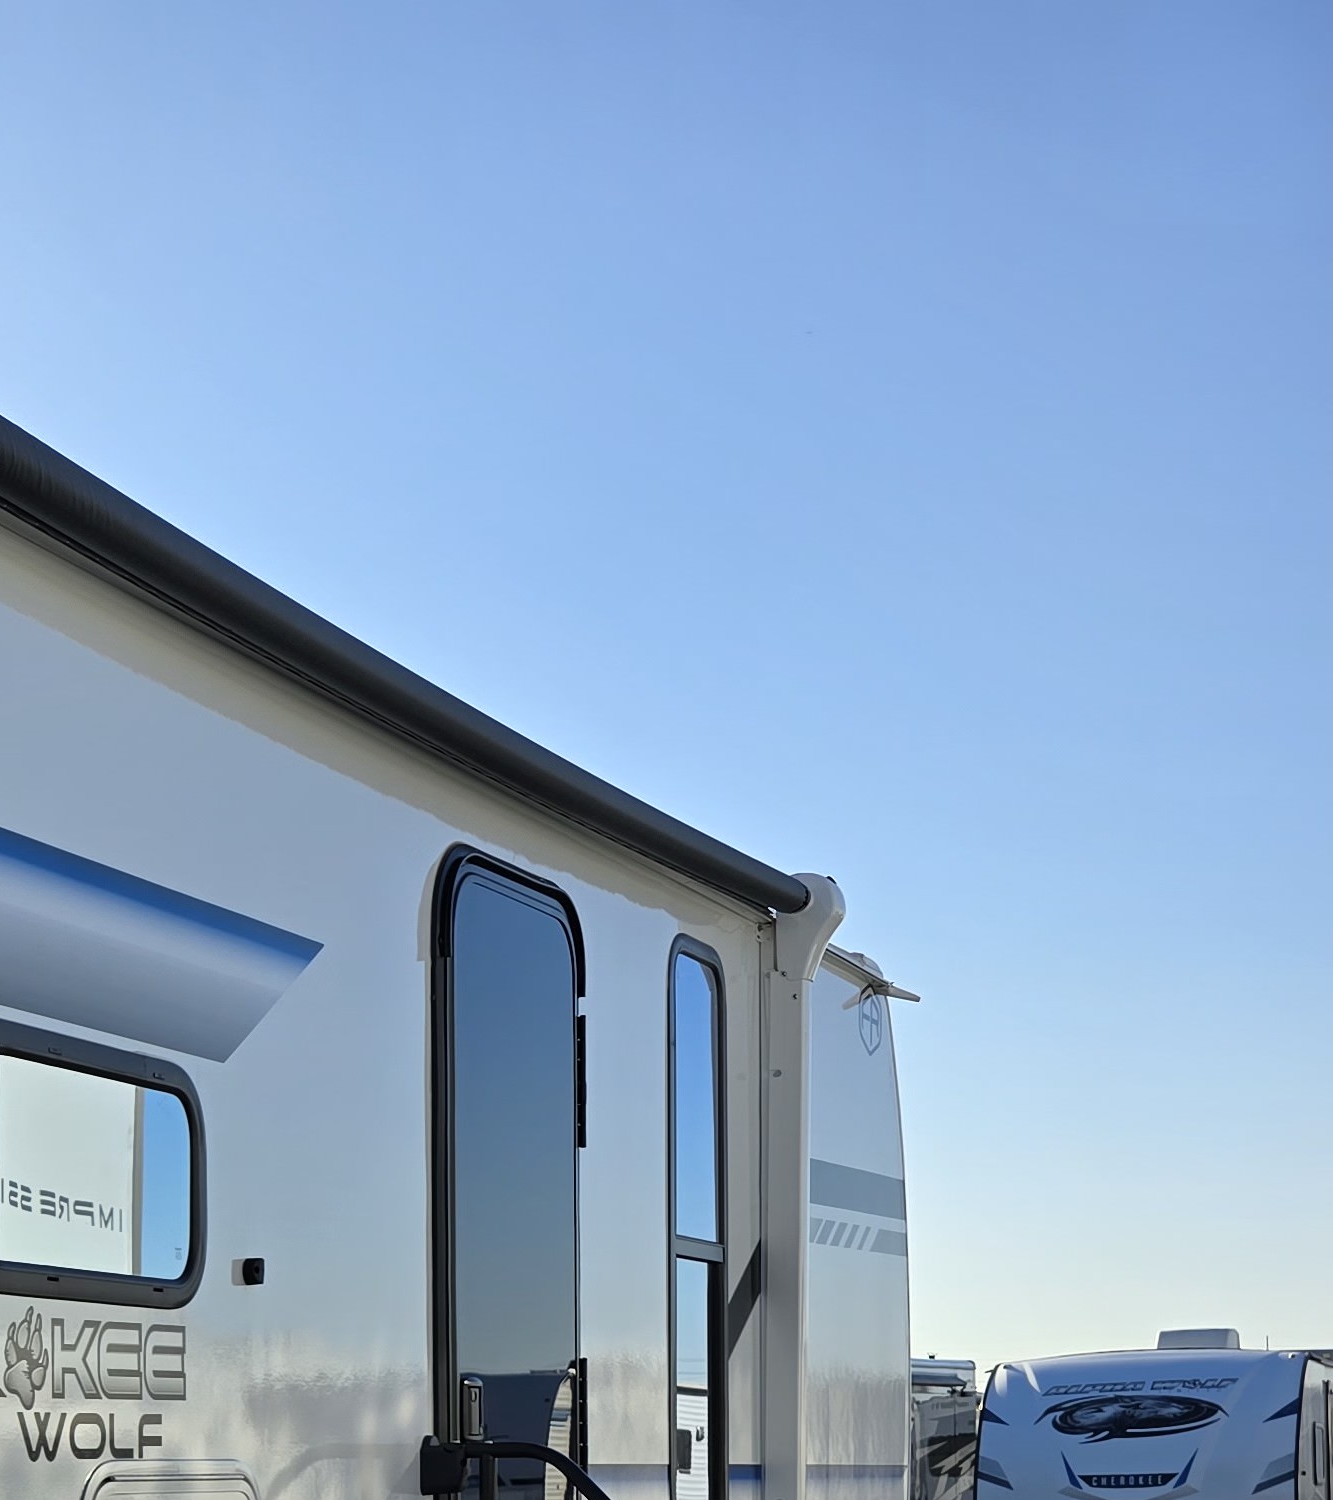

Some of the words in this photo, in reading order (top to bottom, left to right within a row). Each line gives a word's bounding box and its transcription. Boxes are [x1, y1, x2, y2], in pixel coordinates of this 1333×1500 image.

[1042, 1381, 1145, 1396] ALPHA
[17, 1411, 163, 1463] WOLF
[1092, 1475, 1163, 1486] CHEROKEE
